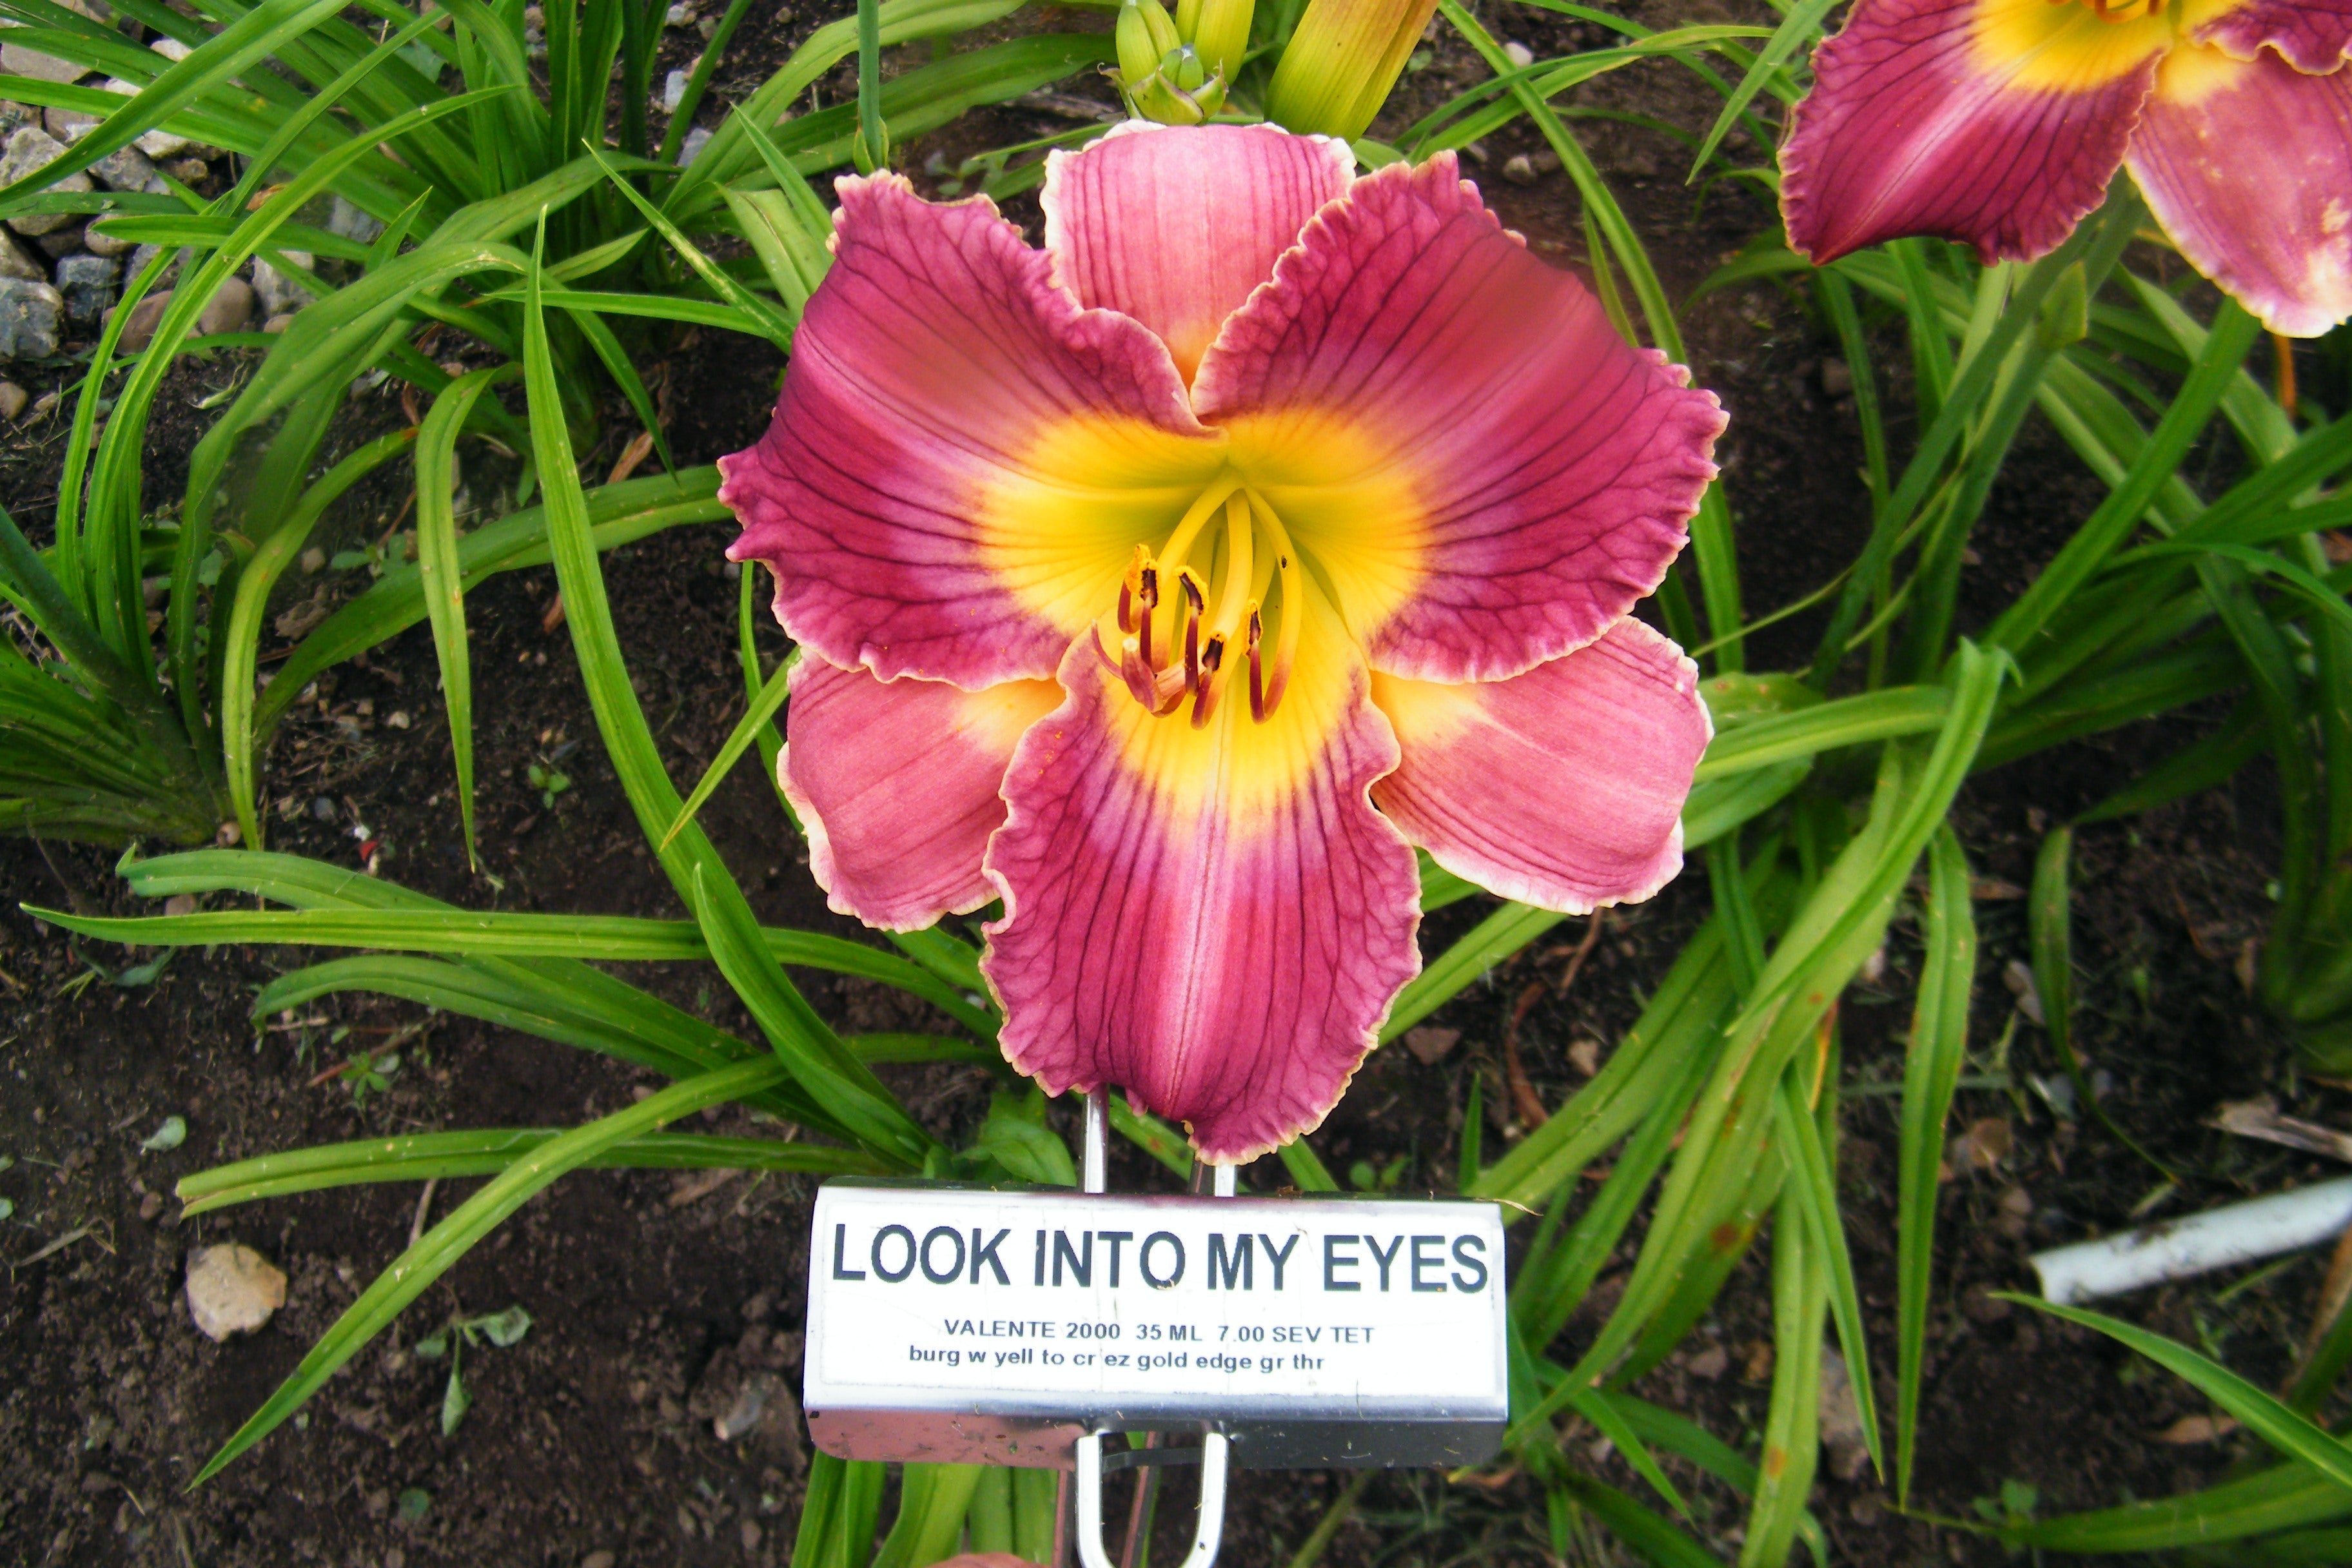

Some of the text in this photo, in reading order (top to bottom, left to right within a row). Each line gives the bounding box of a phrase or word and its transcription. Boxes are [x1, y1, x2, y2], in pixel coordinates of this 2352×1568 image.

[832, 1224, 1487, 1292] LOOK INTO MY EYES
[944, 1319, 1375, 1344] VALENTE 2000 35 ML 7.00 SEV TET
[908, 1344, 1326, 1373] burg w yell to cr ez gold edge gr thr
